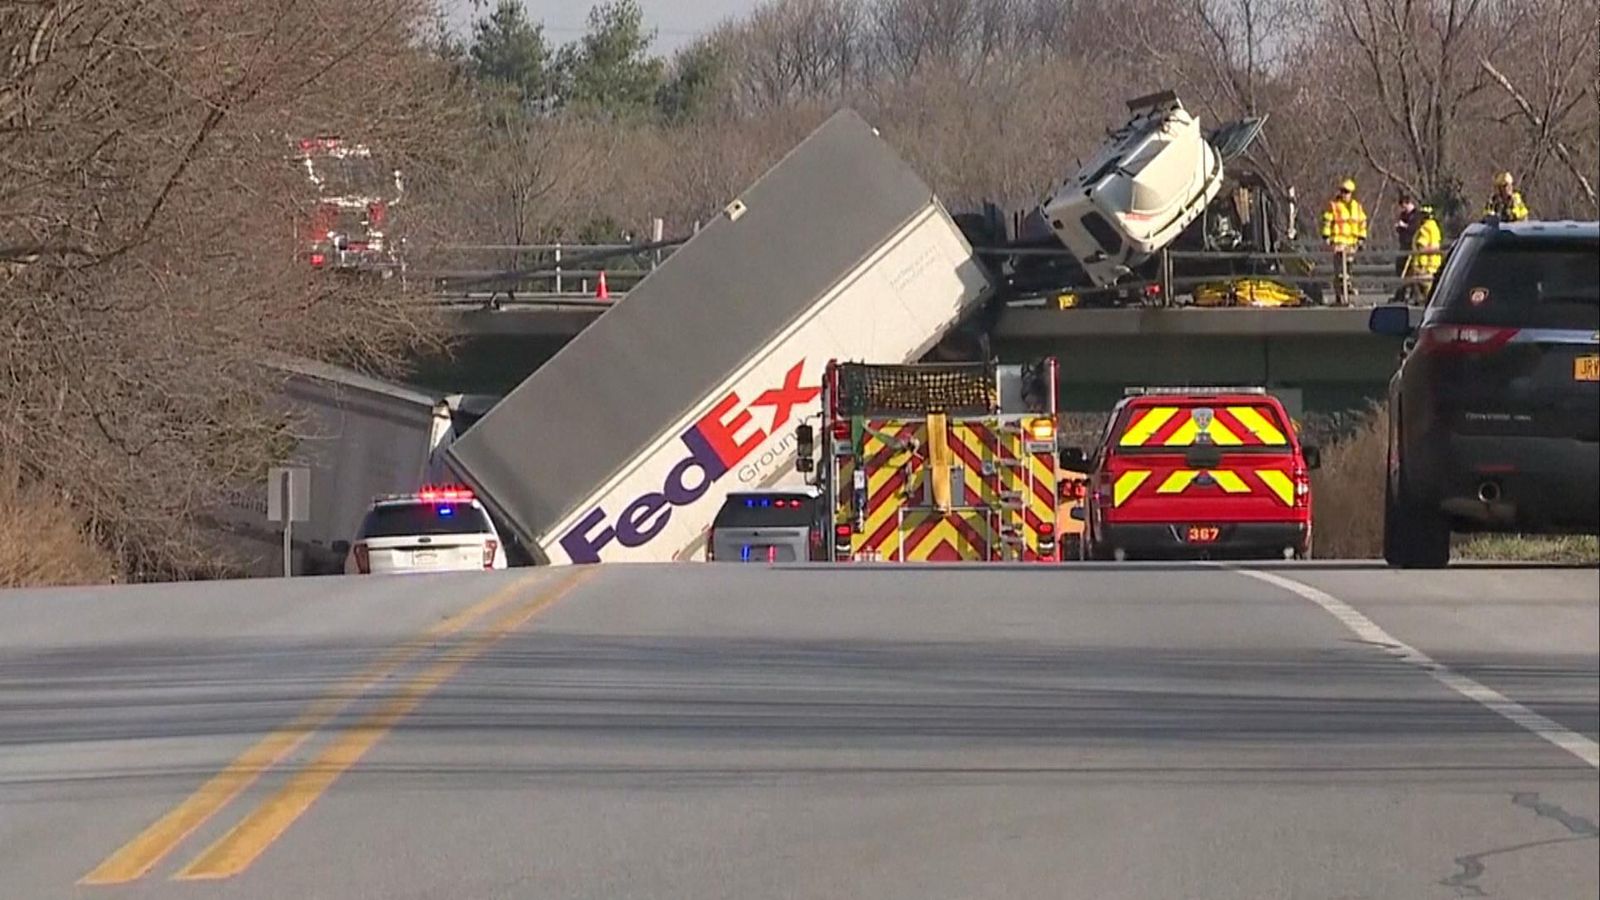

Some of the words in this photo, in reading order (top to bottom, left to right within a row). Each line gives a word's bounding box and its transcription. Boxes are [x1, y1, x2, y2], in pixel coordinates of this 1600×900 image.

[559, 357, 821, 563] FedEx
[738, 420, 803, 483] Groun
[1189, 528, 1219, 541] 367
